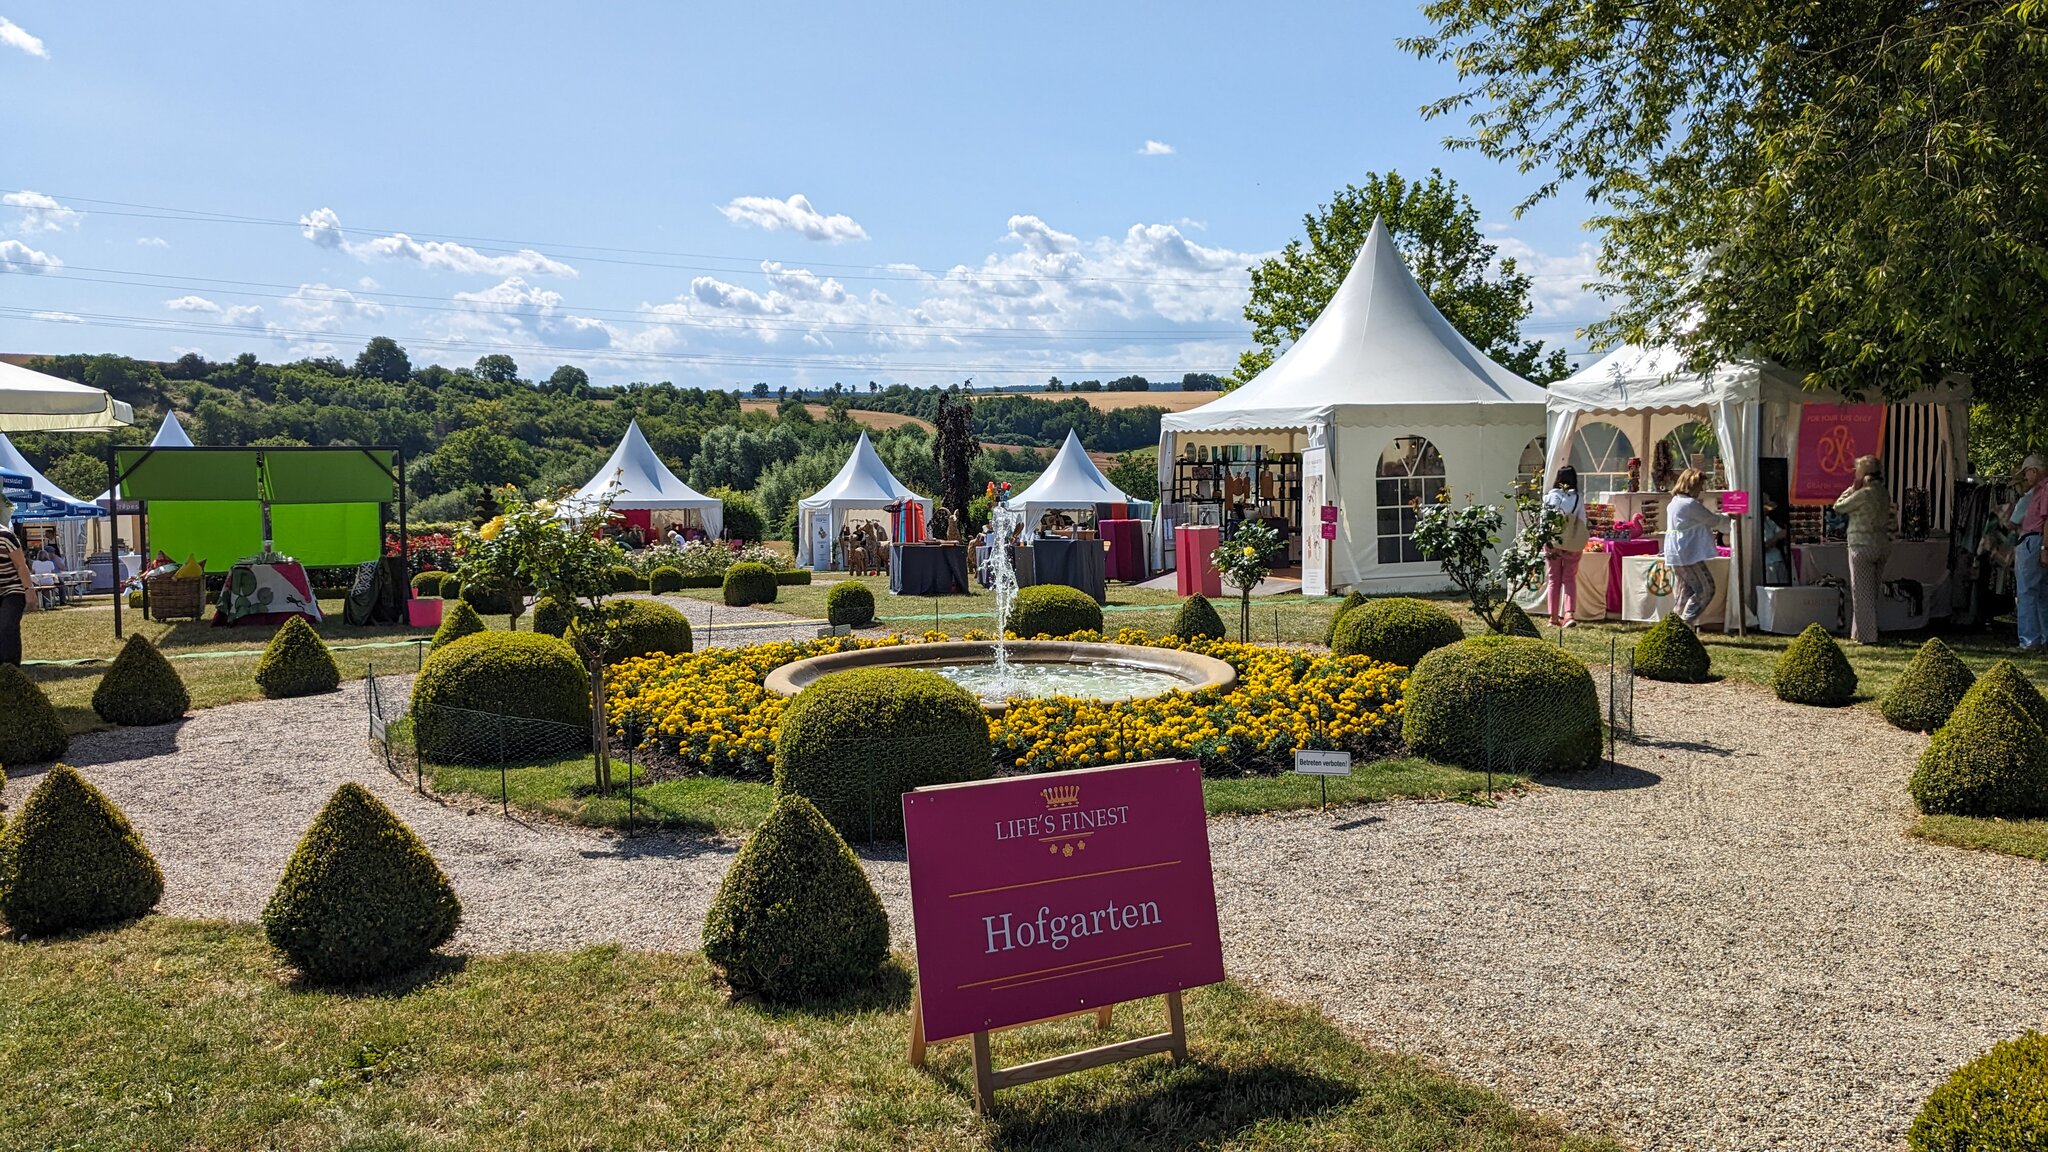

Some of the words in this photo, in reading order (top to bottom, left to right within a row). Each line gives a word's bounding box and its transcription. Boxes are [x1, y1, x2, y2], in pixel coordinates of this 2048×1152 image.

[1299, 758, 1322, 767] Betreten
[1322, 759, 1348, 768] verboten!
[995, 814, 1056, 841] LIFE'S
[1060, 805, 1129, 833] FINEST
[981, 899, 1163, 954] Hofgarten
